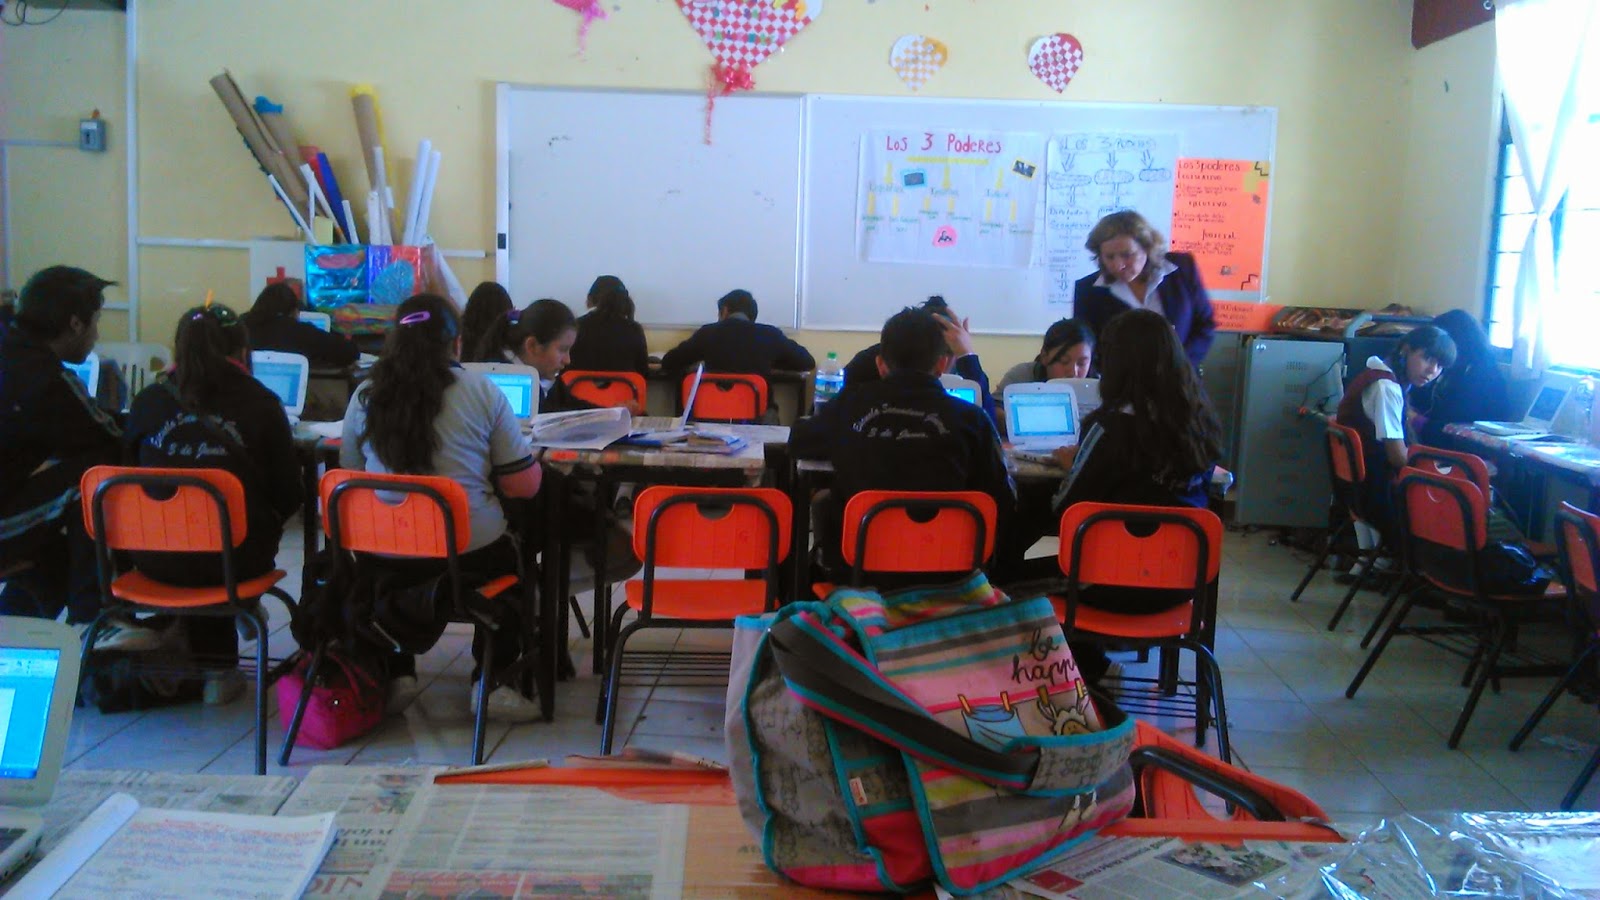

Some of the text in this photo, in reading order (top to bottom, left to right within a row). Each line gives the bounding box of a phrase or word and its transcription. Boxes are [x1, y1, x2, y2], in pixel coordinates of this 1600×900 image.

[921, 133, 934, 150] 3
[1028, 627, 1060, 661] be
[1011, 653, 1076, 686] happ
